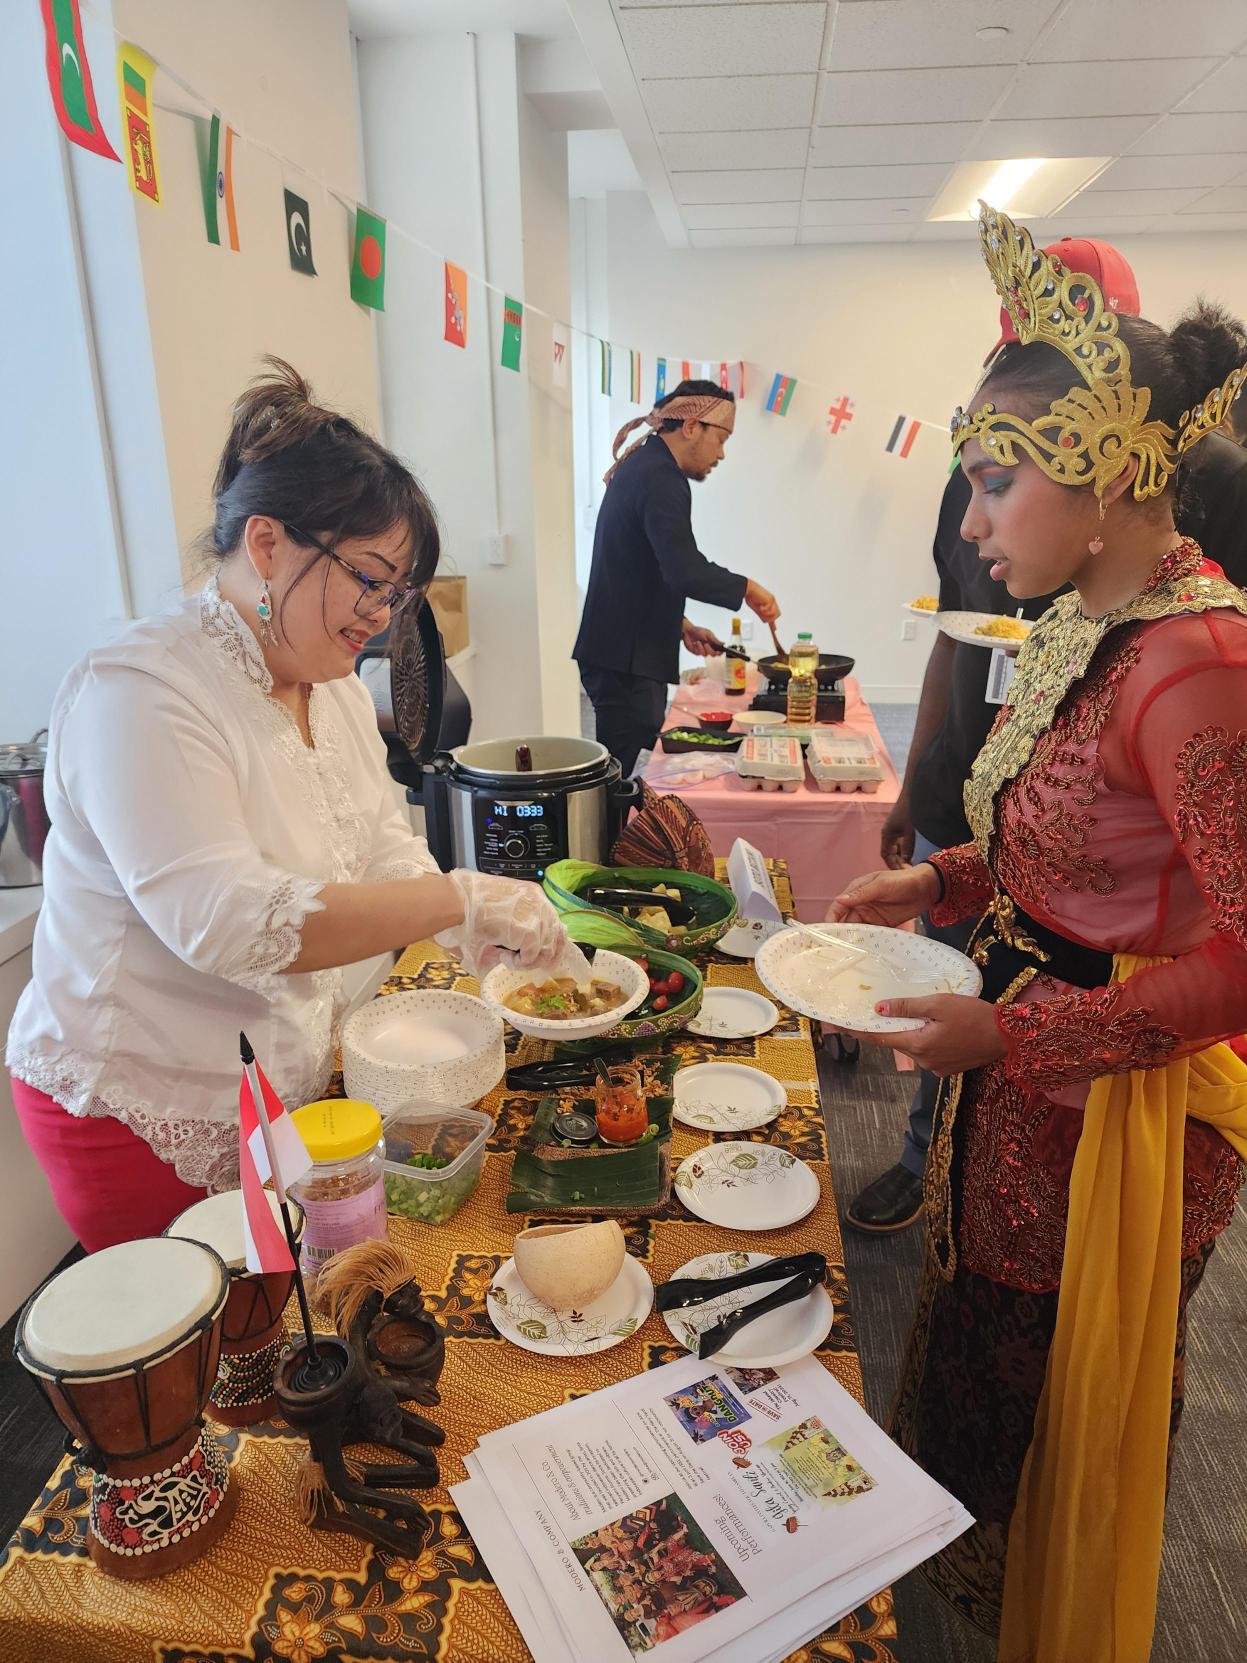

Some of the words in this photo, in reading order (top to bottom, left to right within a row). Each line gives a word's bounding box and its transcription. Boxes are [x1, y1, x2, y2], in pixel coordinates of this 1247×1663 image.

[516, 805, 543, 816] 0333
[701, 1383, 738, 1423] DANGDUT
[748, 1400, 763, 1408] DATE
[767, 1409, 781, 1420] SAVE
[718, 1430, 746, 1454] JOIN
[731, 1430, 752, 1449] US!
[535, 1510, 559, 1547] COMPANY
[713, 1494, 763, 1555] Performances!
[715, 1515, 750, 1562] Upcoming
[561, 1556, 586, 1592] MODERO
